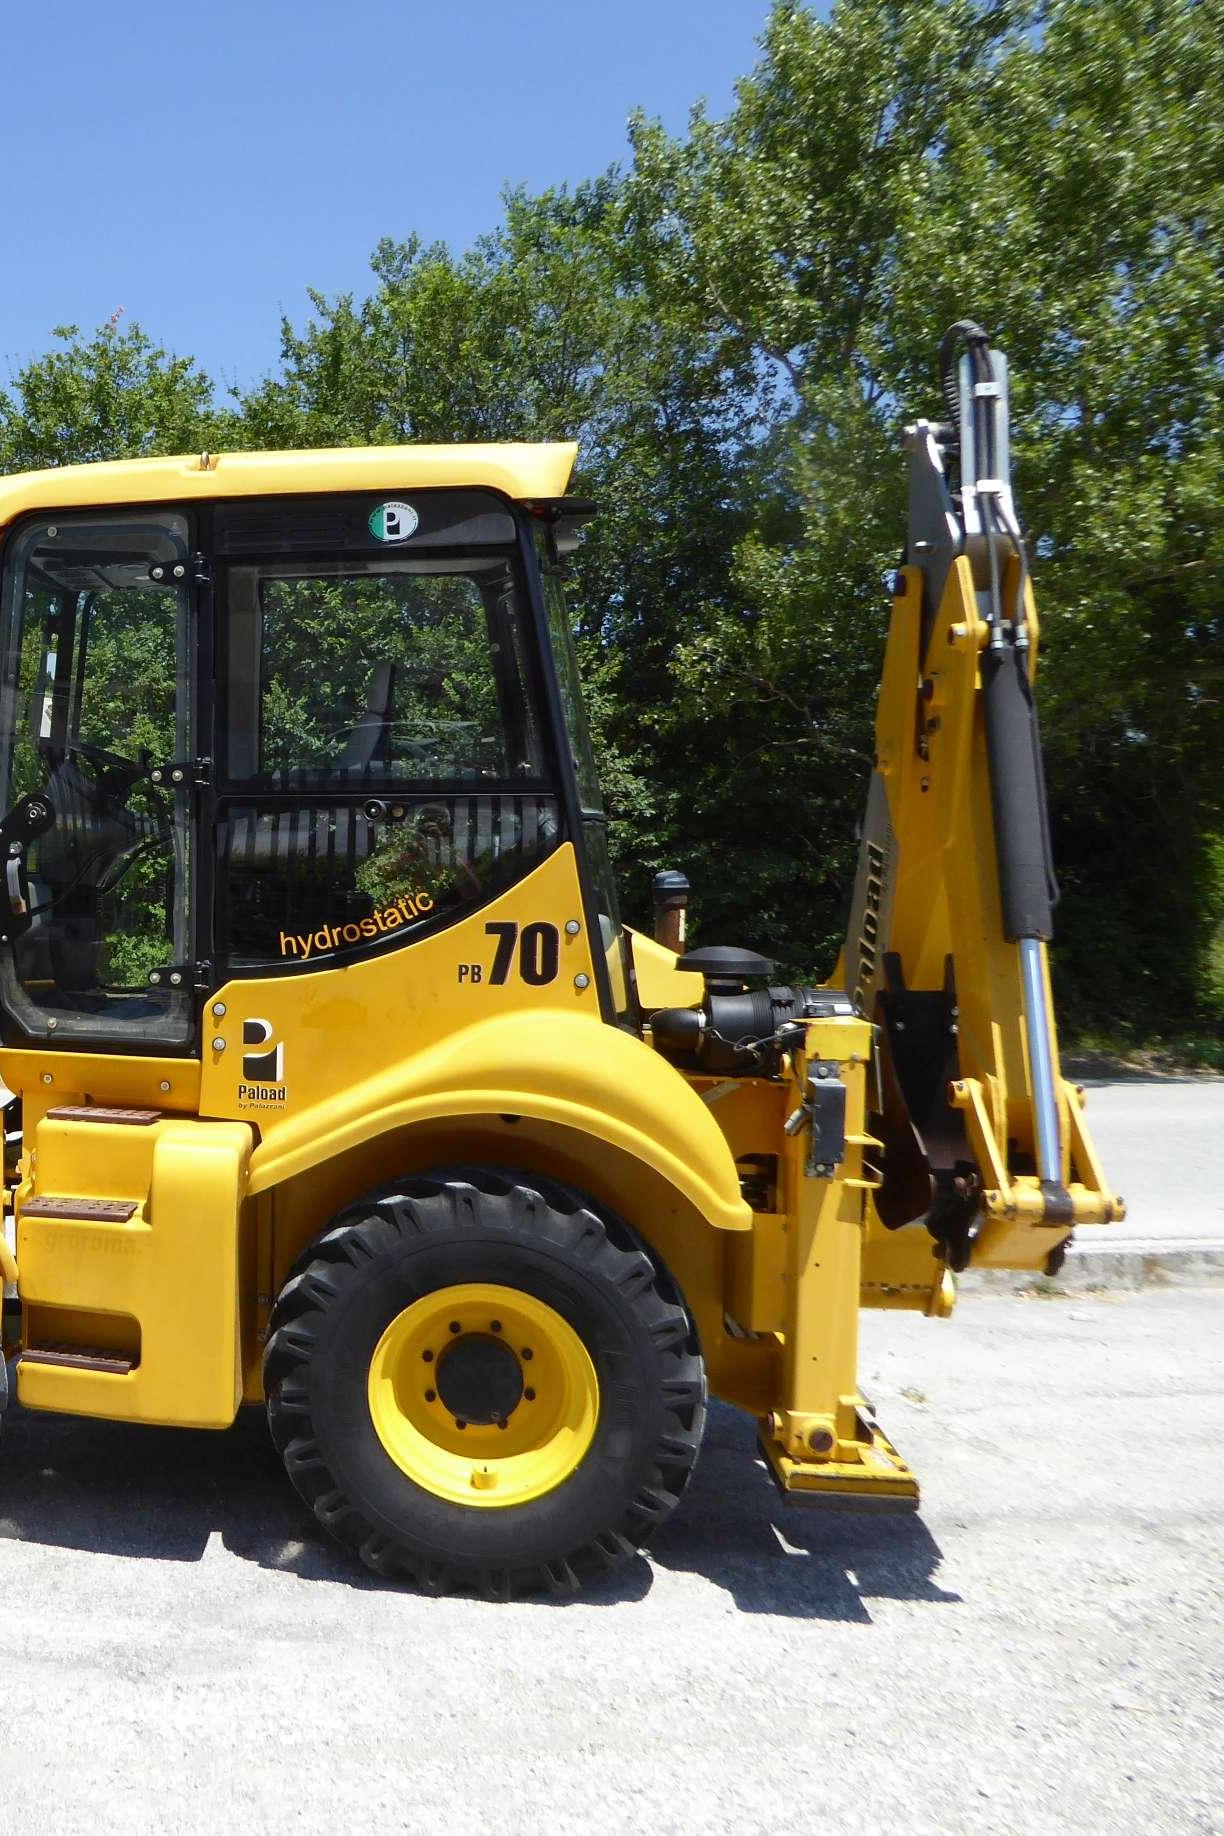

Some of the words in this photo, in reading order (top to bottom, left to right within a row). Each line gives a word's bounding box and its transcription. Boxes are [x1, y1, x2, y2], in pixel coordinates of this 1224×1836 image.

[280, 890, 435, 959] hydrostatic
[458, 964, 482, 984] PB
[485, 921, 559, 985] 70
[238, 1085, 286, 1100] Paload
